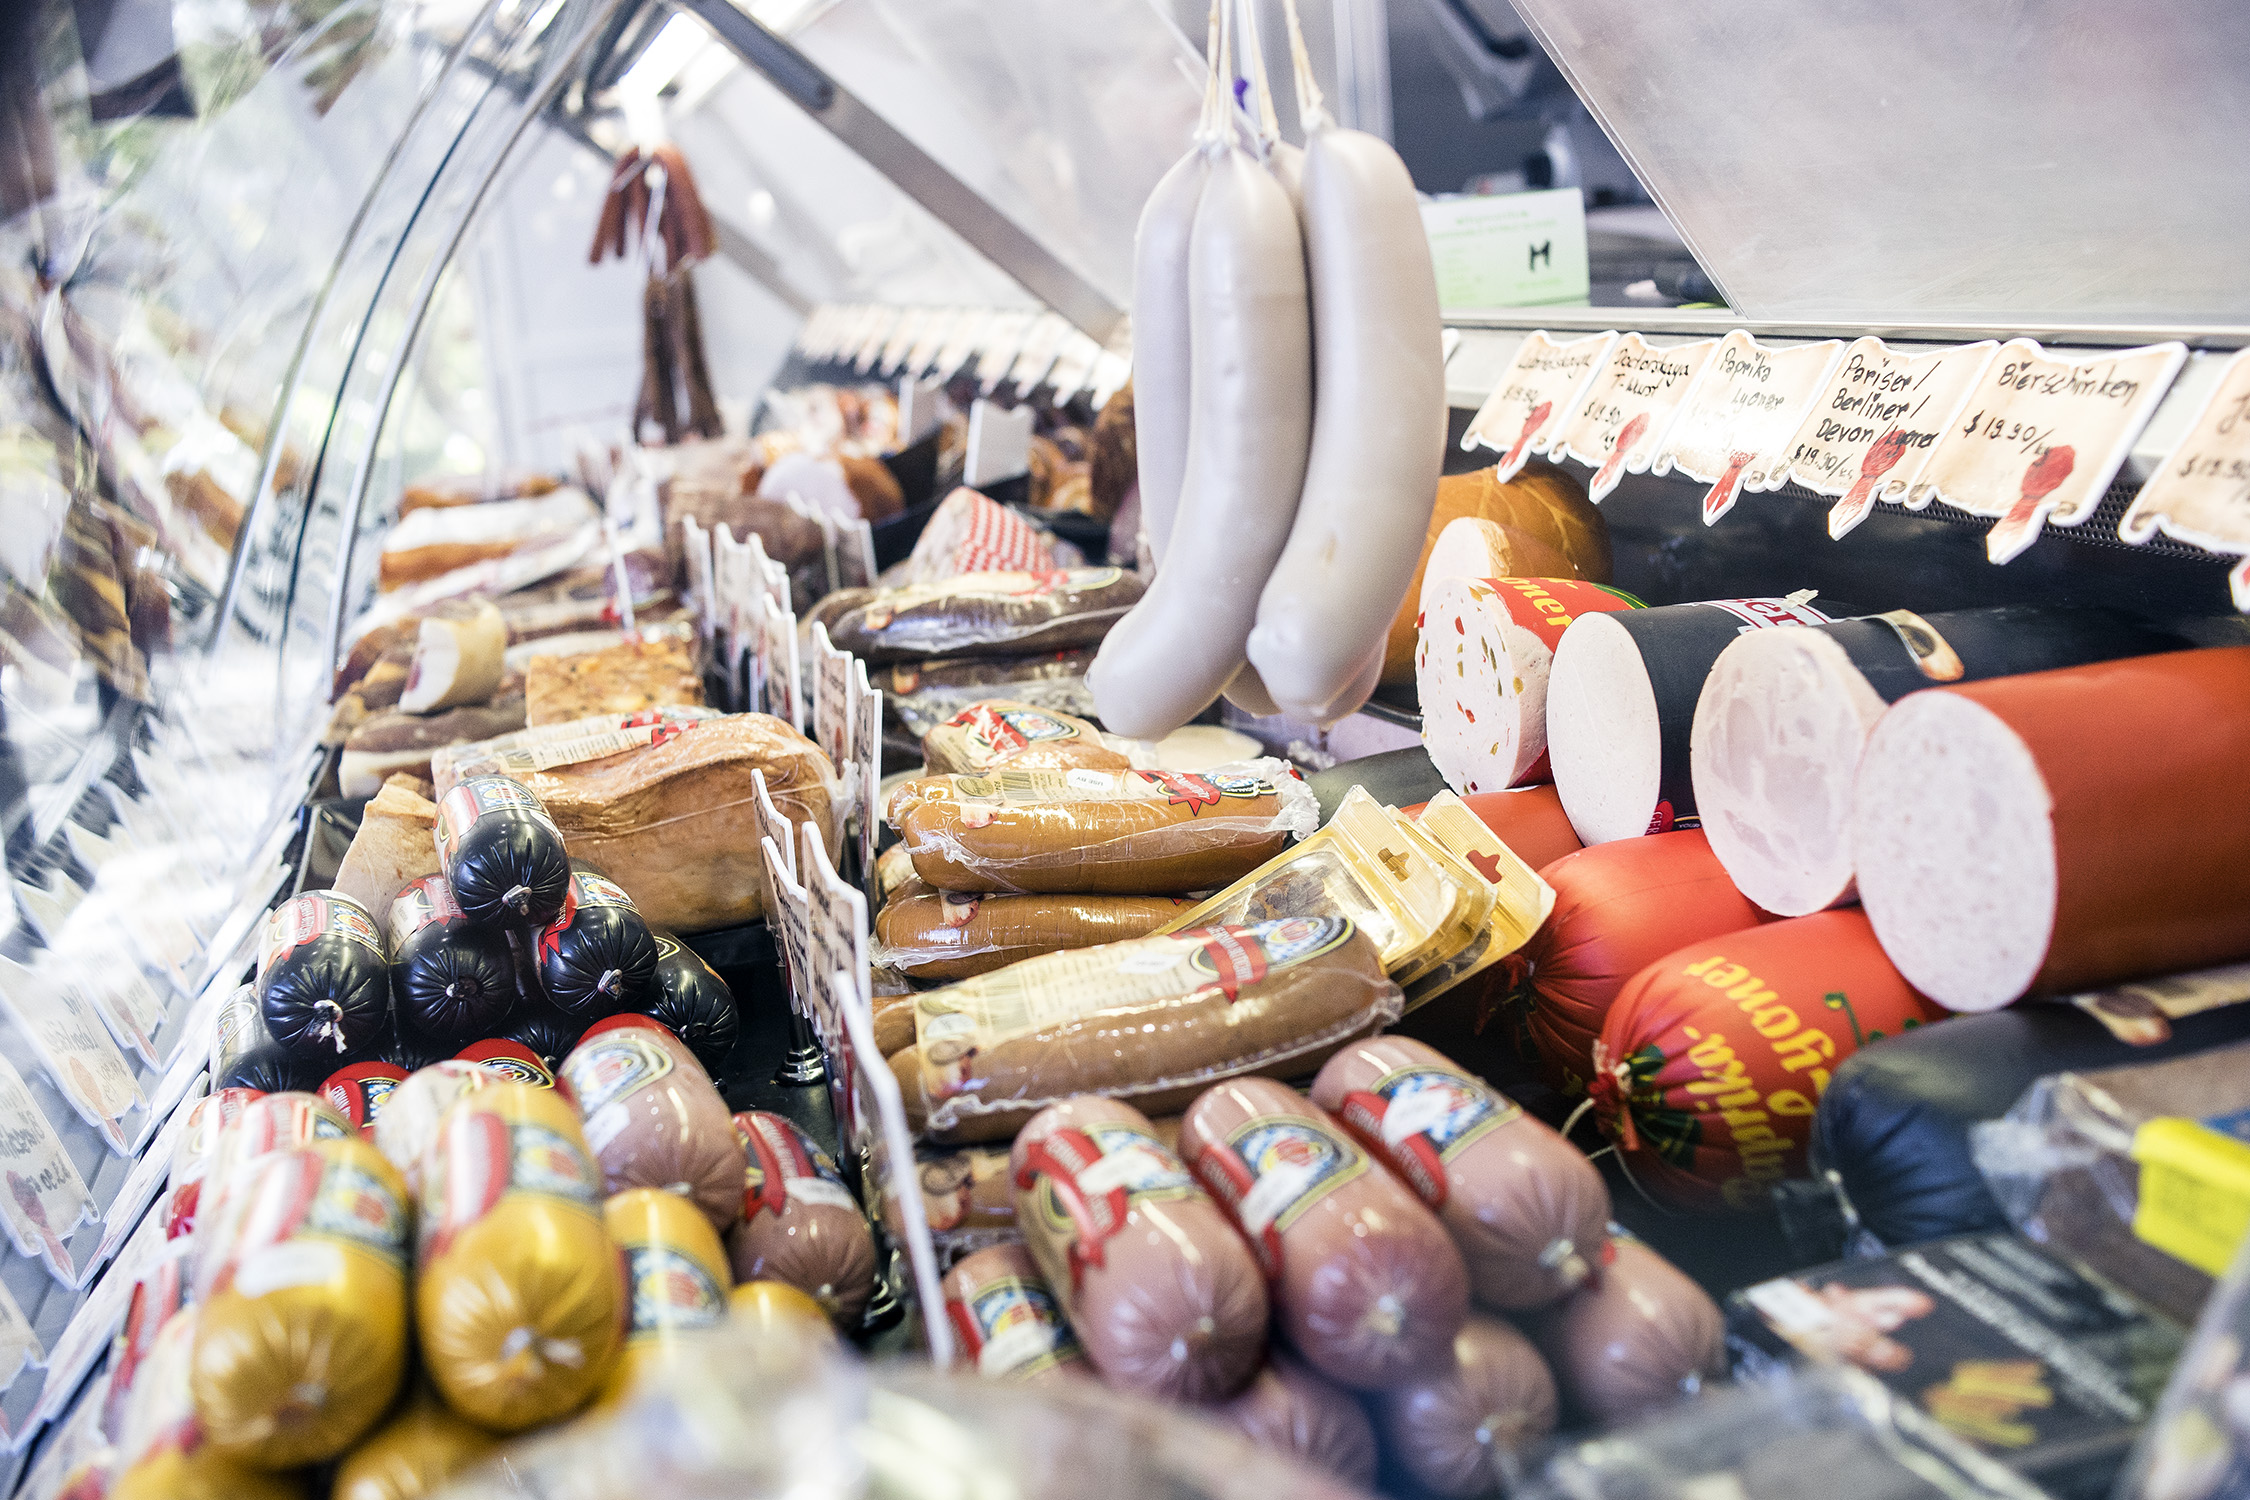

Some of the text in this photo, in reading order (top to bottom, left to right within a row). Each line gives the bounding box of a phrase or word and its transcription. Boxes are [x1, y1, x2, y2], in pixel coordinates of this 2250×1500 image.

[1718, 347, 1772, 382] Paprika
[1730, 387, 1785, 413] Lyoner
[1999, 361, 2139, 407] Bierschinken
